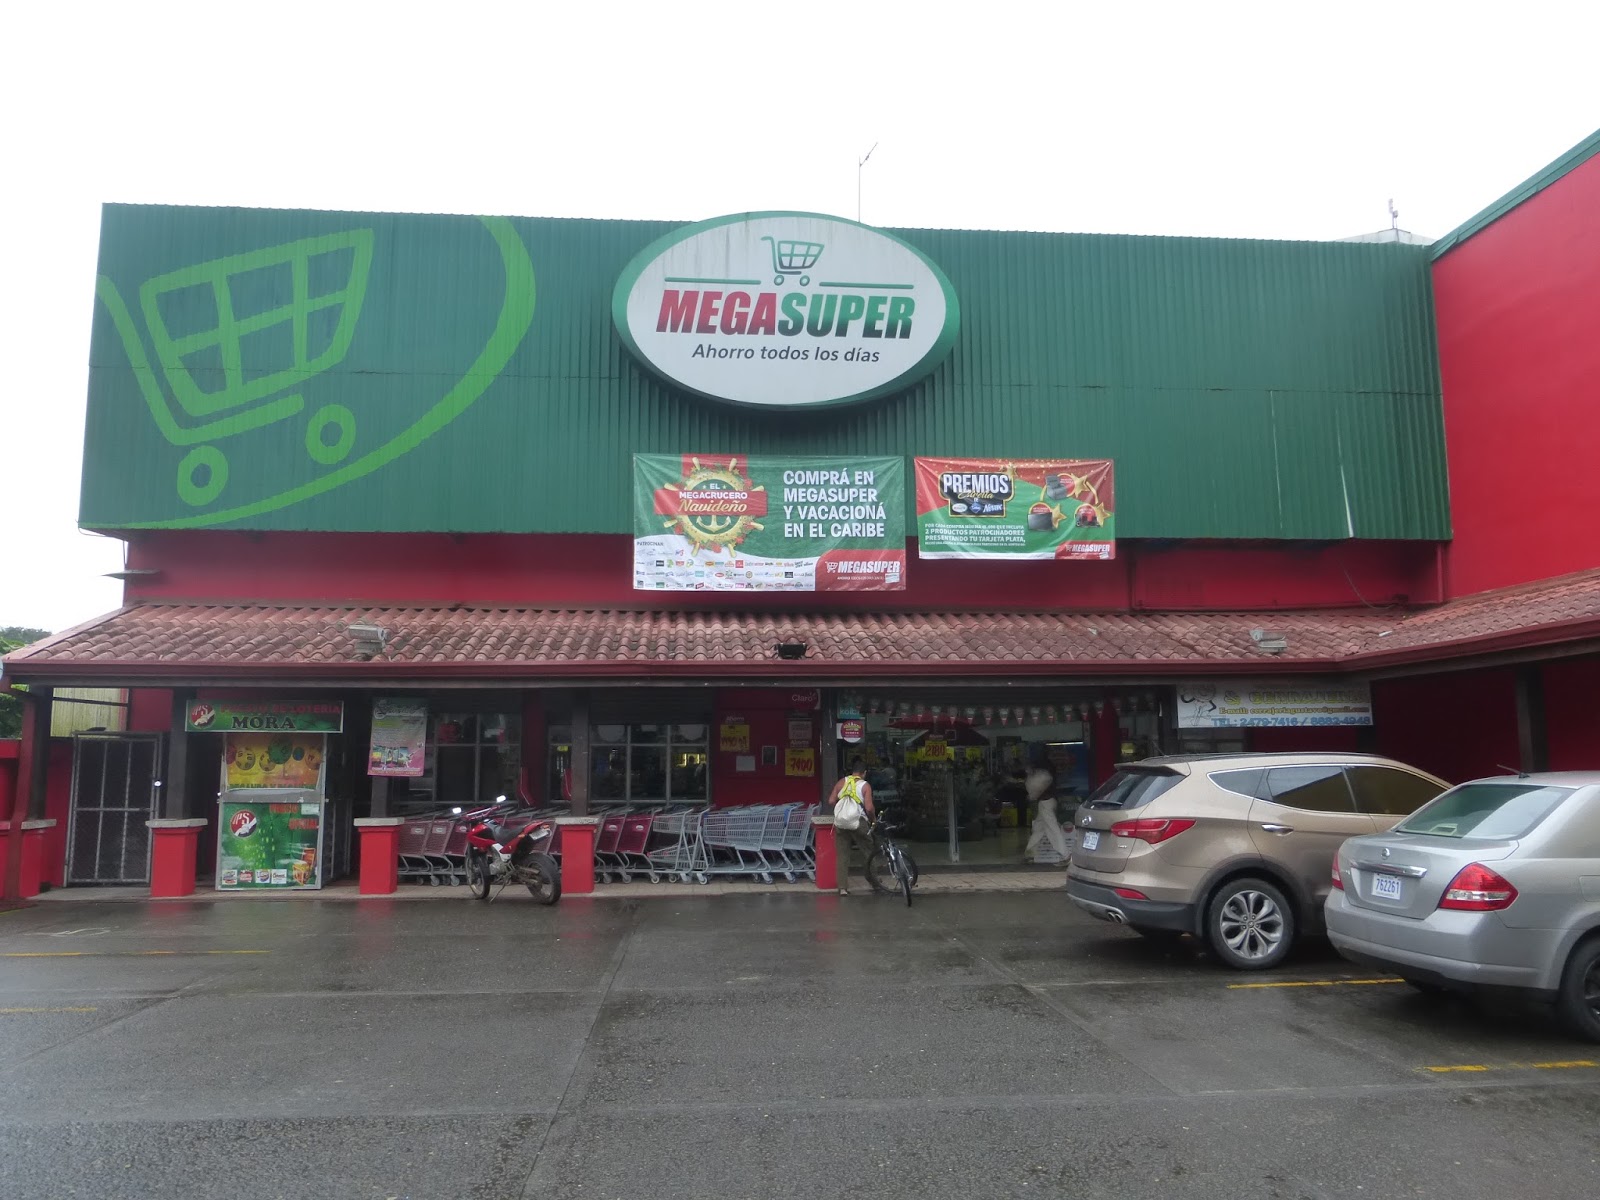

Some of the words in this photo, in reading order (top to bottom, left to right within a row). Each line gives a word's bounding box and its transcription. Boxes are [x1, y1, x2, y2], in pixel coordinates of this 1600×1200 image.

[655, 289, 916, 339] MEGASUPER
[692, 344, 755, 360] Ahorro
[760, 345, 810, 361] todos
[814, 346, 839, 362] los
[844, 347, 881, 363] días
[783, 467, 850, 486] COMPRÁ
[854, 470, 875, 486] EN
[943, 474, 1009, 494] PREMIOS
[679, 491, 748, 499] MEGACRUCERO
[783, 488, 878, 503] MEGASUPER
[678, 499, 748, 512] Navideño
[783, 505, 792, 520] Y
[796, 502, 887, 520] VACACIONÁ
[784, 523, 804, 538] EN
[809, 523, 826, 538] EL
[830, 523, 885, 538] CARIBE
[837, 561, 901, 574] MEGASUPER
[231, 716, 296, 729] MORA
[1375, 878, 1400, 895] 762261
